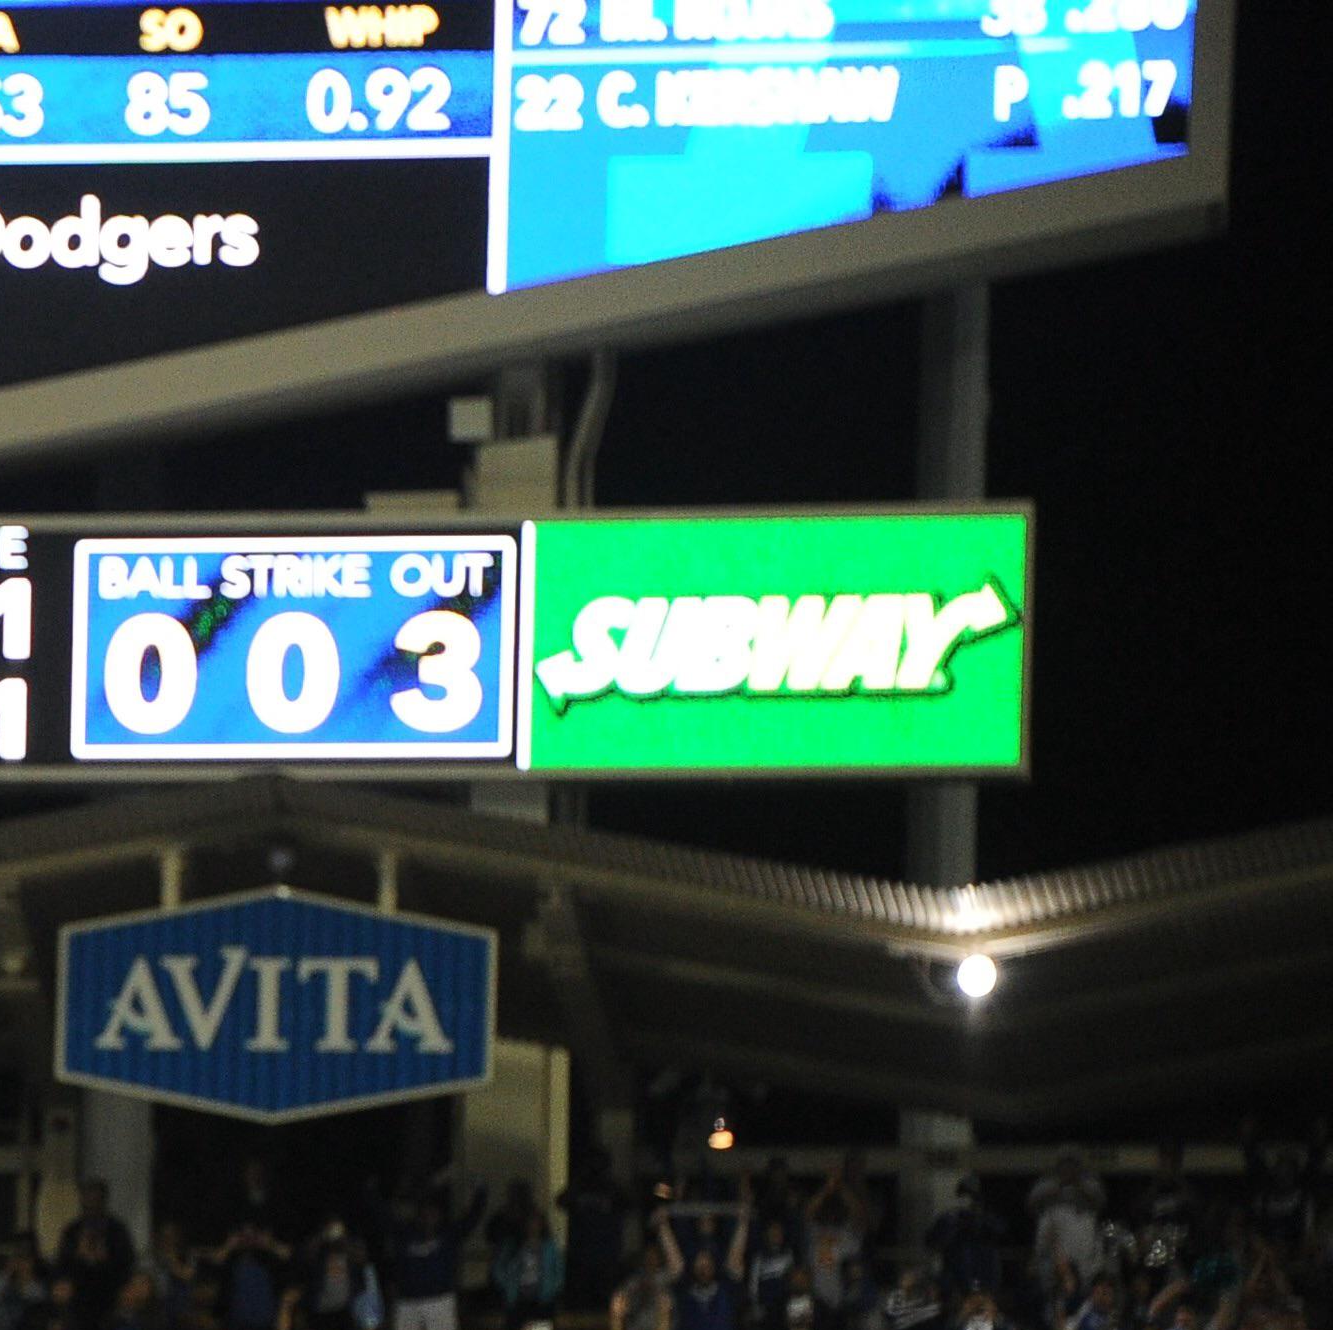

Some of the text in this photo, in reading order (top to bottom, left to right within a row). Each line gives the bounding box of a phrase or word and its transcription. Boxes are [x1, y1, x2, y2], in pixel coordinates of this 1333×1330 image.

[139, 7, 204, 52] SO
[324, 4, 440, 49] WHIP
[125, 71, 211, 136] 85
[306, 66, 452, 133] 0.92
[514, 73, 585, 131] 22
[596, 70, 650, 129] C.
[992, 65, 1029, 122] P
[1062, 60, 1178, 120] .217
[98, 552, 495, 599] BALL STRIKE OUT
[103, 609, 483, 736] 0 0 3
[538, 588, 1013, 705] SUBWAY
[93, 944, 455, 1054] AVITA
